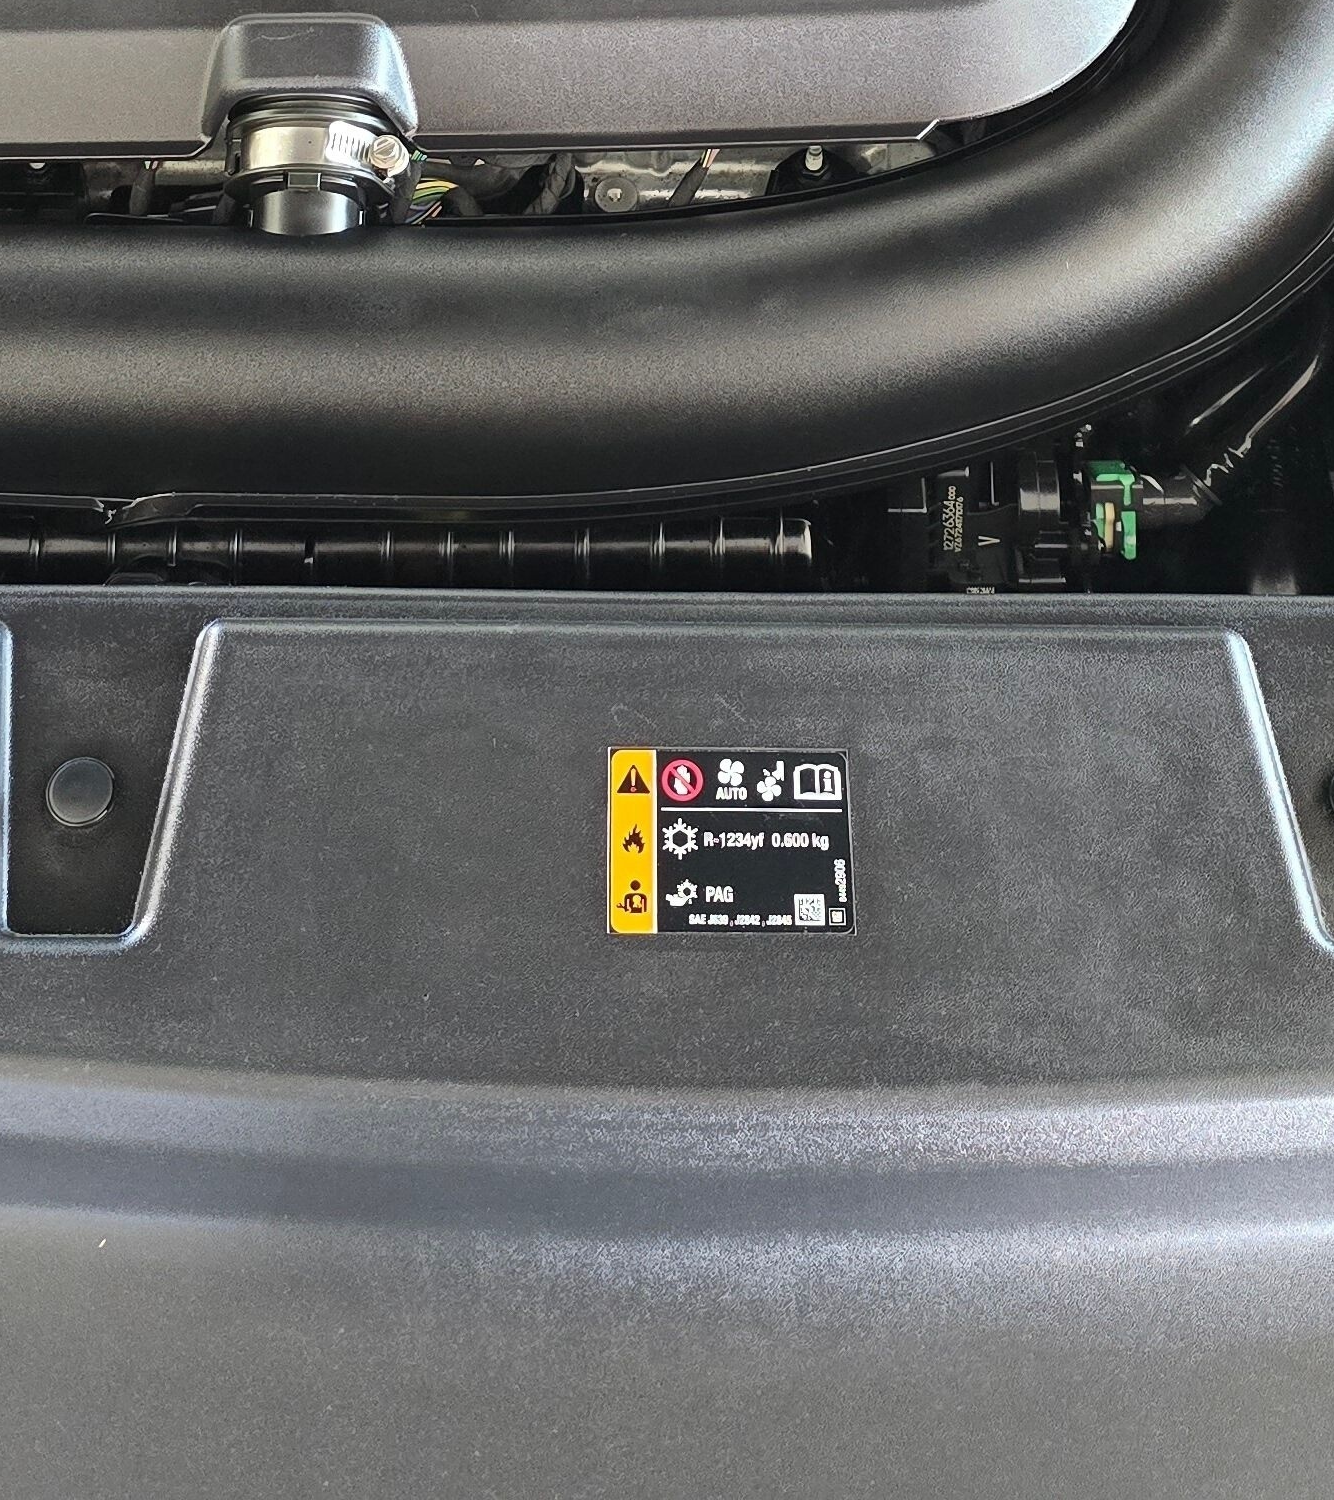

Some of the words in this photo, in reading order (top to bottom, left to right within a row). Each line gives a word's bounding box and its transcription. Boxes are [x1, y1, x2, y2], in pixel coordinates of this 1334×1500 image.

[715, 786, 748, 801] AUTO
[703, 832, 765, 849] R-1234yf
[771, 832, 810, 848] 0.600
[811, 831, 830, 851] kg
[705, 886, 734, 903] PAG
[688, 913, 707, 925] SAE
